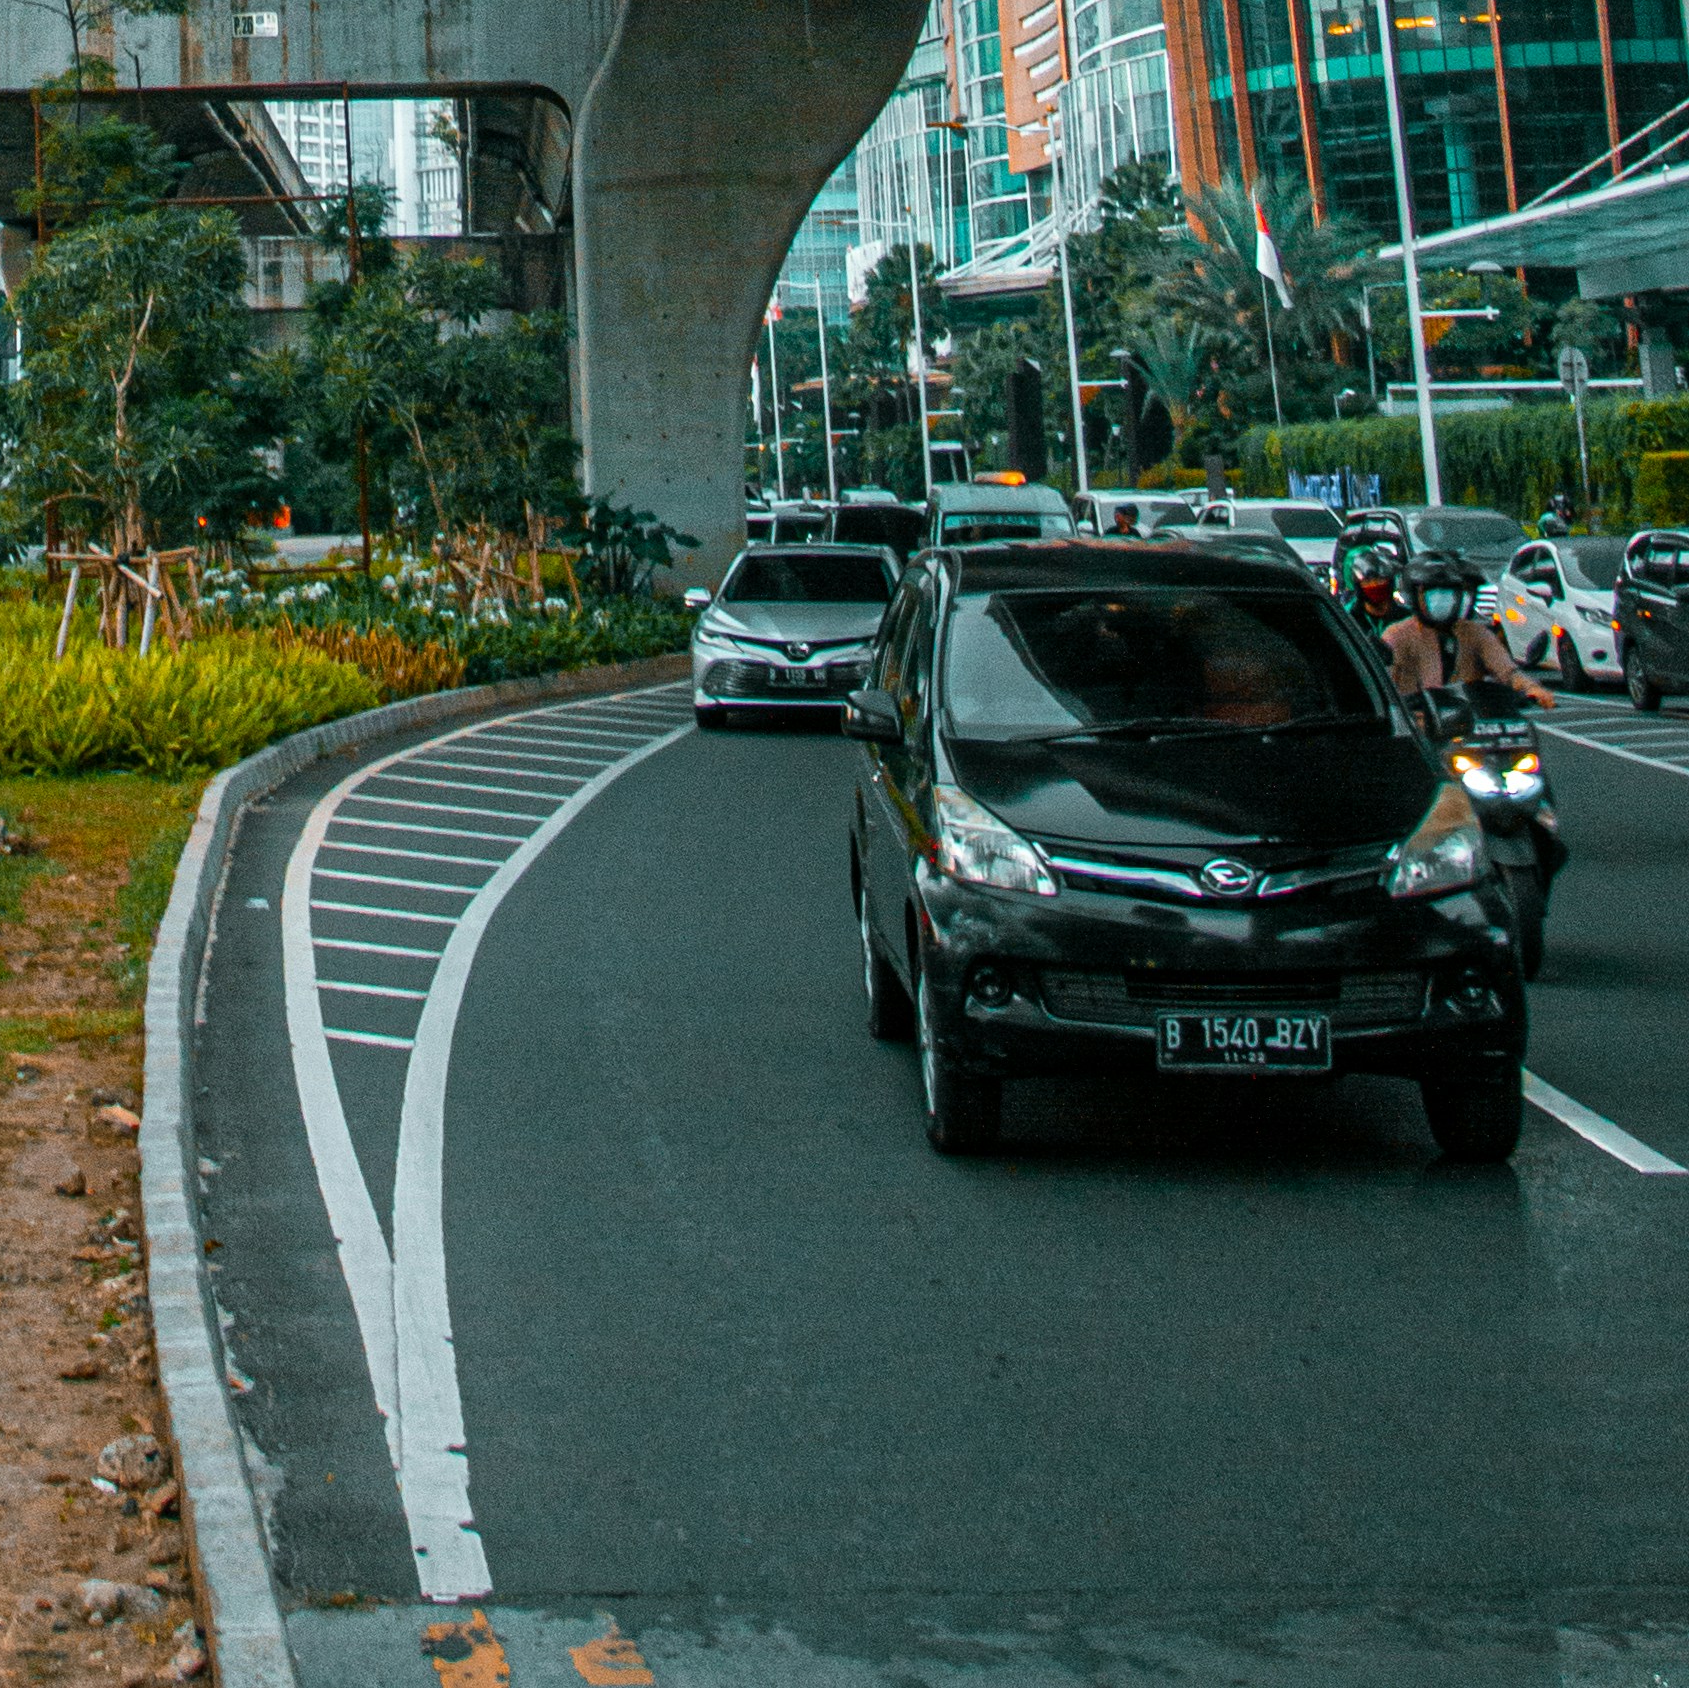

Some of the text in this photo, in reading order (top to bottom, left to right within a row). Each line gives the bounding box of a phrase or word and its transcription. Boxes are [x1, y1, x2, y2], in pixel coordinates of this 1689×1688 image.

[1166, 1017, 1321, 1050] B 1540 BZY
